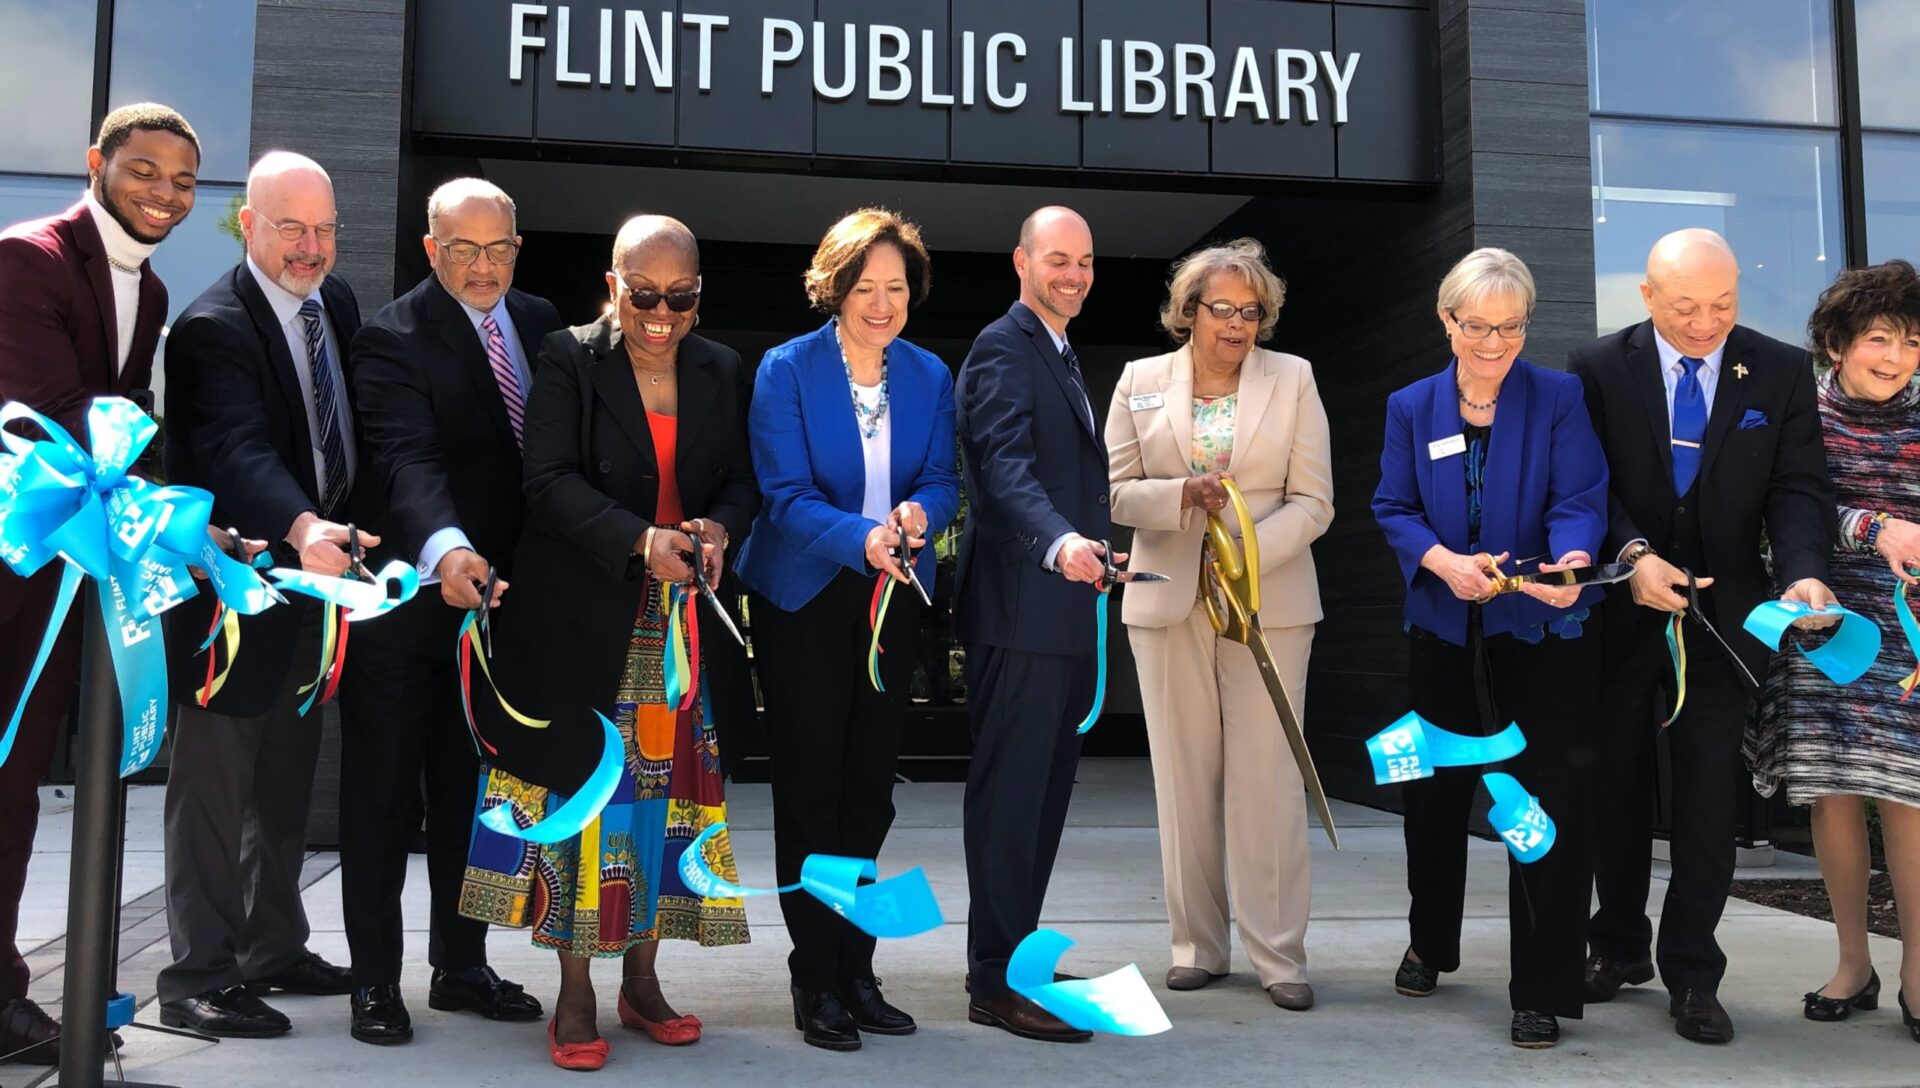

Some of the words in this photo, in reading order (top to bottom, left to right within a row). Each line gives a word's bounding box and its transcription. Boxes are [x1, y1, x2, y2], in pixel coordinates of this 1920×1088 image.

[509, 3, 730, 93] FLINT
[761, 17, 1028, 111] PUBLIC
[1059, 36, 1361, 125] LIBRARY
[131, 725, 141, 757] FLINT
[138, 709, 149, 752] PUBLIC
[146, 698, 158, 747] LIBRARY
